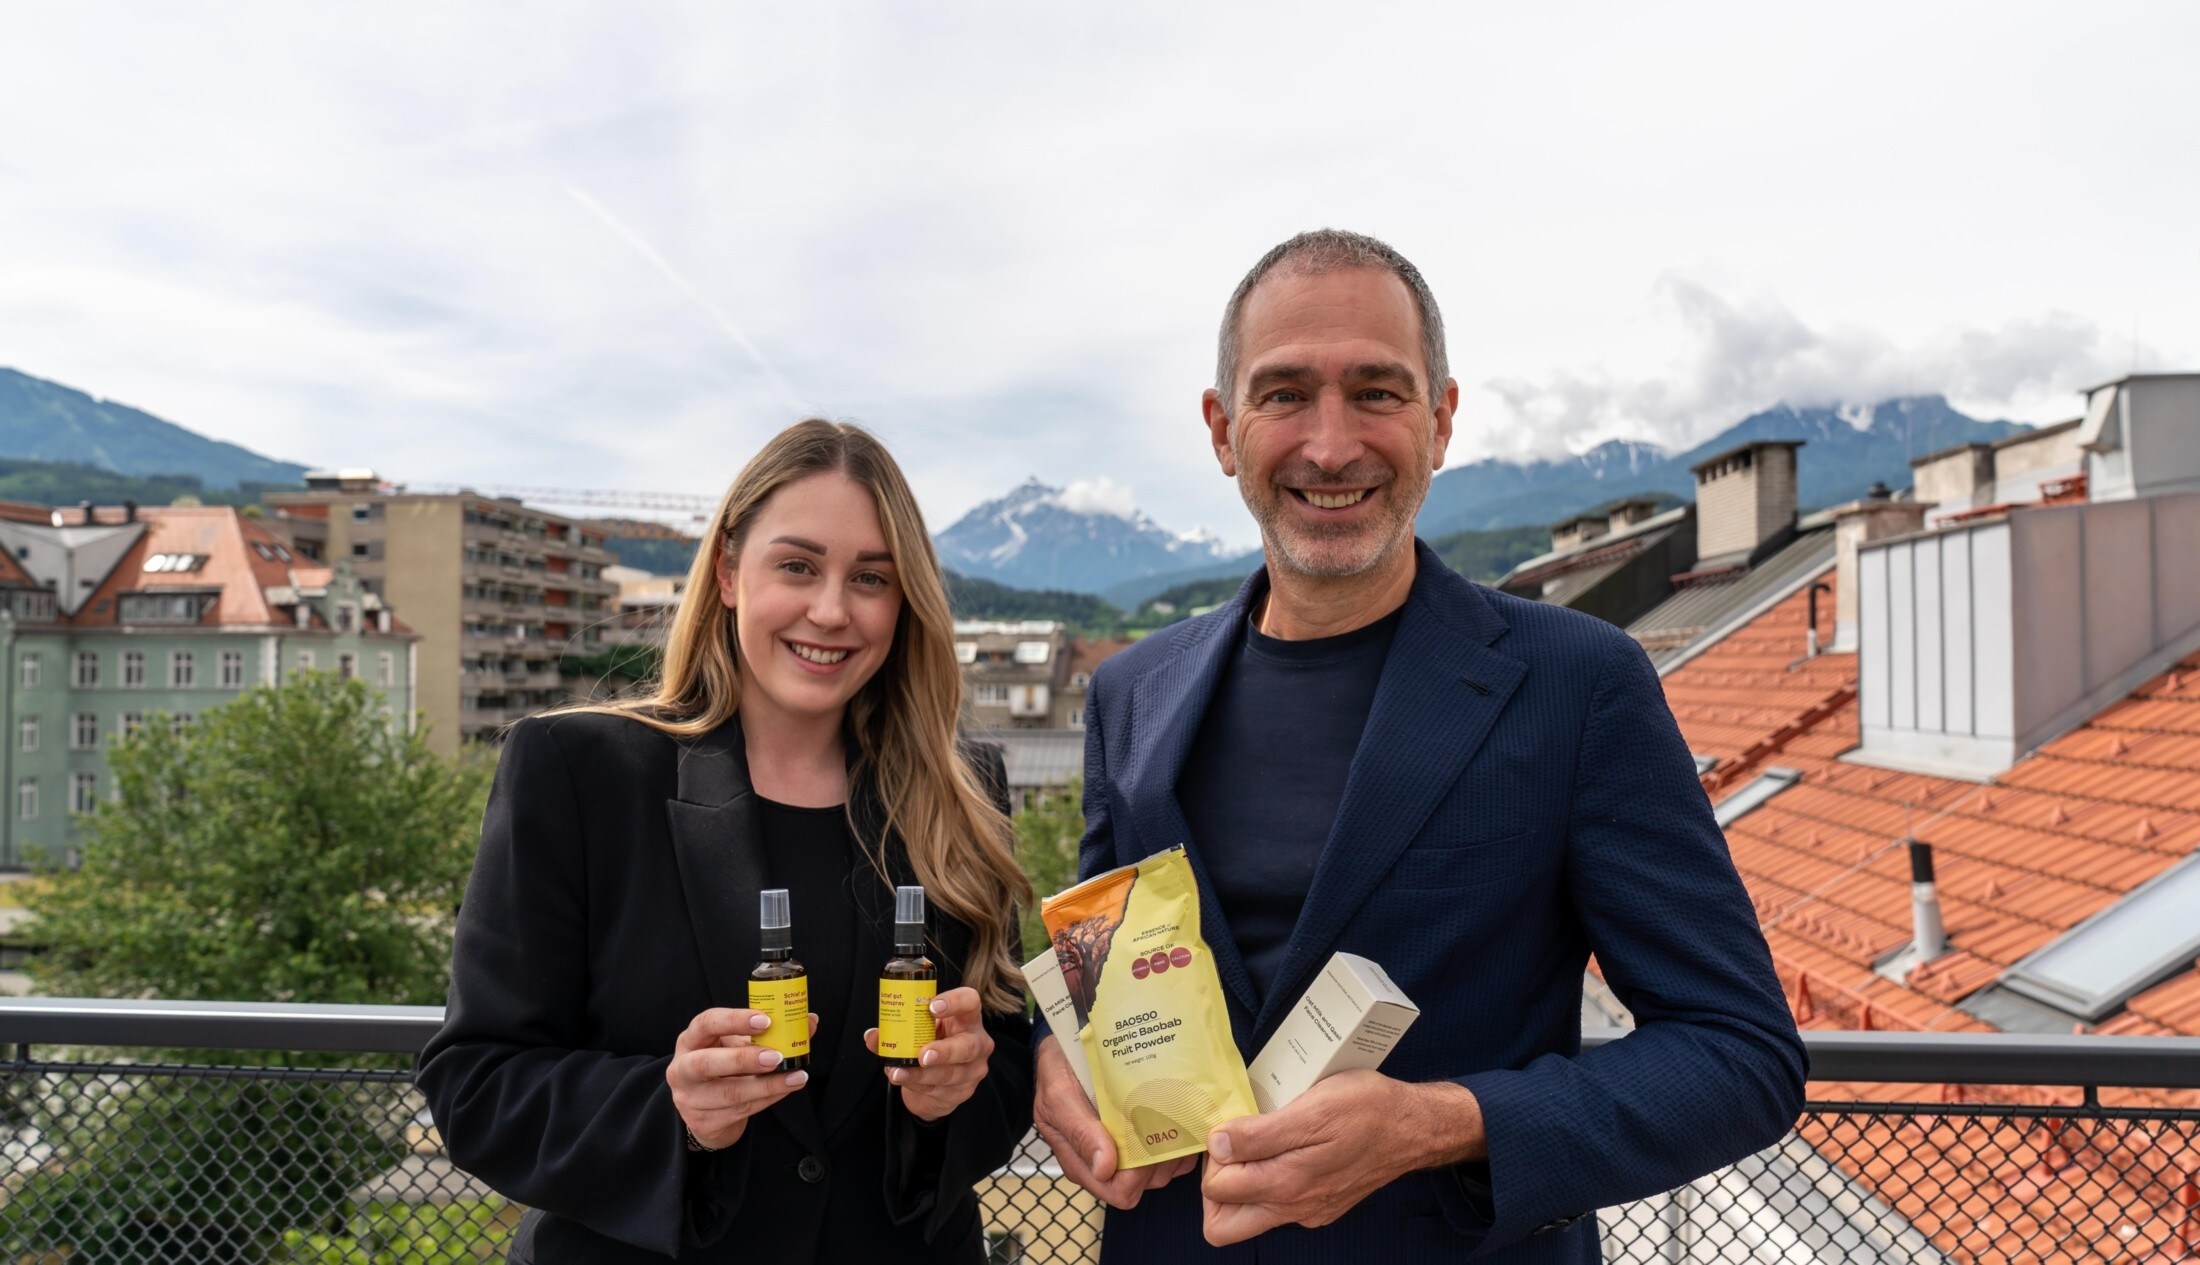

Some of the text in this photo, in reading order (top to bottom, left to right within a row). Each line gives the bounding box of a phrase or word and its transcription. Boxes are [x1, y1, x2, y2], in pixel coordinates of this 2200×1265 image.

[1132, 925, 1180, 942] AFRICAN NATURE
[1140, 946, 1165, 956] SOURCE
[1045, 1005, 1054, 1013] Oat
[1052, 1008, 1064, 1017] Face
[1306, 996, 1314, 1006] Oat
[1322, 1016, 1331, 1028] and
[1102, 1018, 1182, 1048] Organic Baobab
[1304, 1005, 1333, 1042] Face Cleanser
[1112, 1034, 1176, 1058] Fruit Powder
